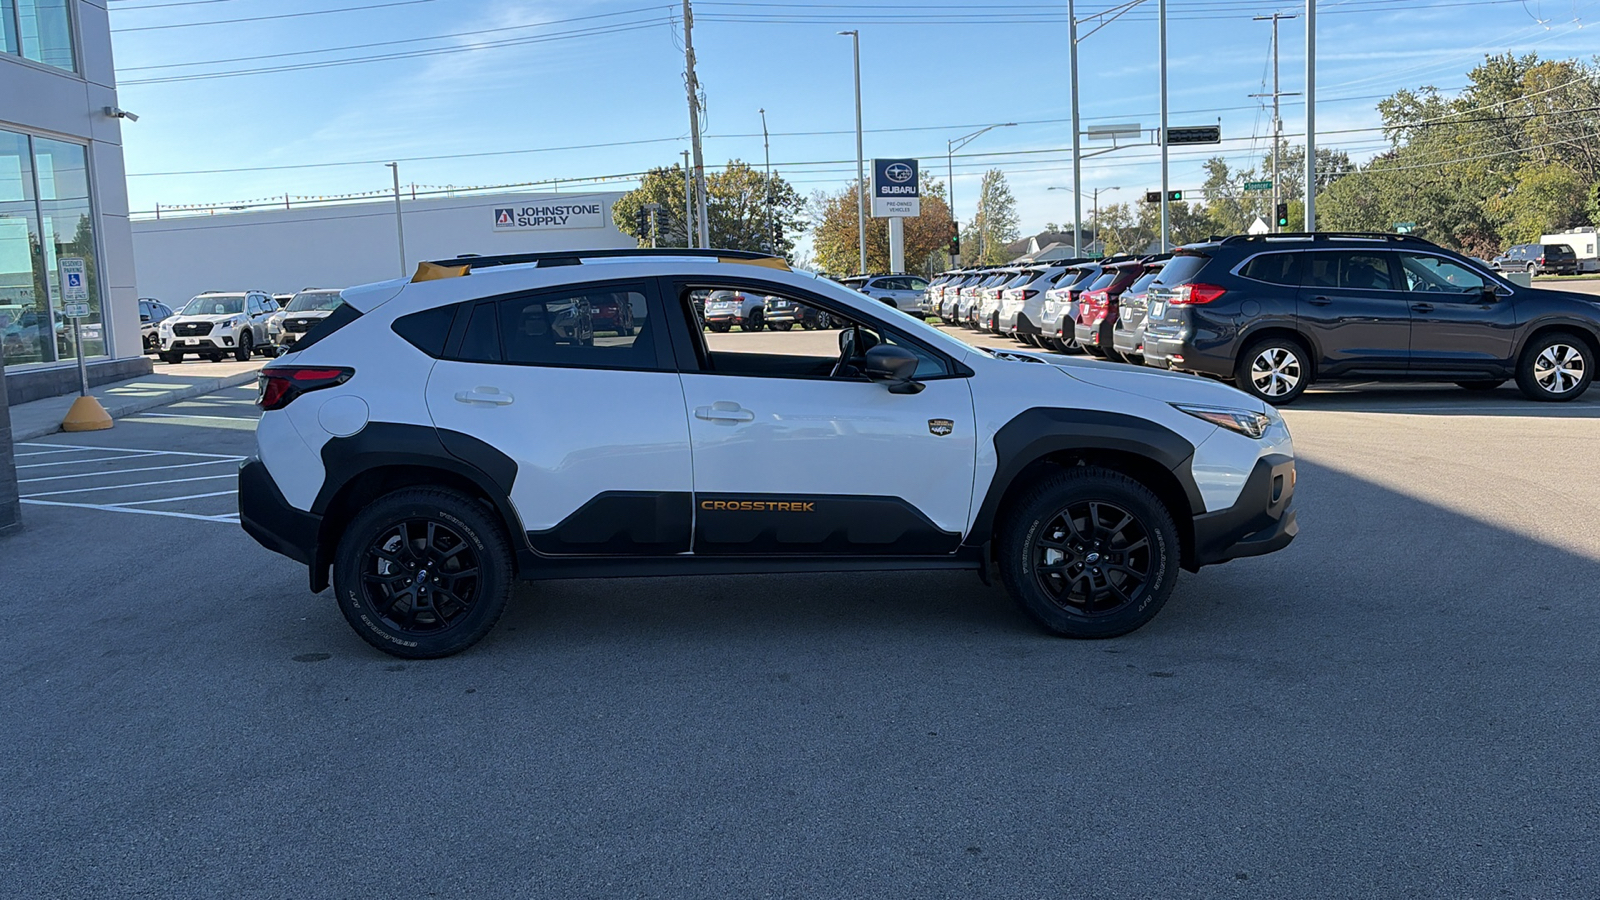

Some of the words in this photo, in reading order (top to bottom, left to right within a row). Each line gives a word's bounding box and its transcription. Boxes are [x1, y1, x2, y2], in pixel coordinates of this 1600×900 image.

[881, 186, 916, 194] SUBARU
[517, 204, 600, 217] JOHNSTONE
[518, 216, 569, 227] SUPPLY
[701, 500, 815, 512] CROSSTREK
